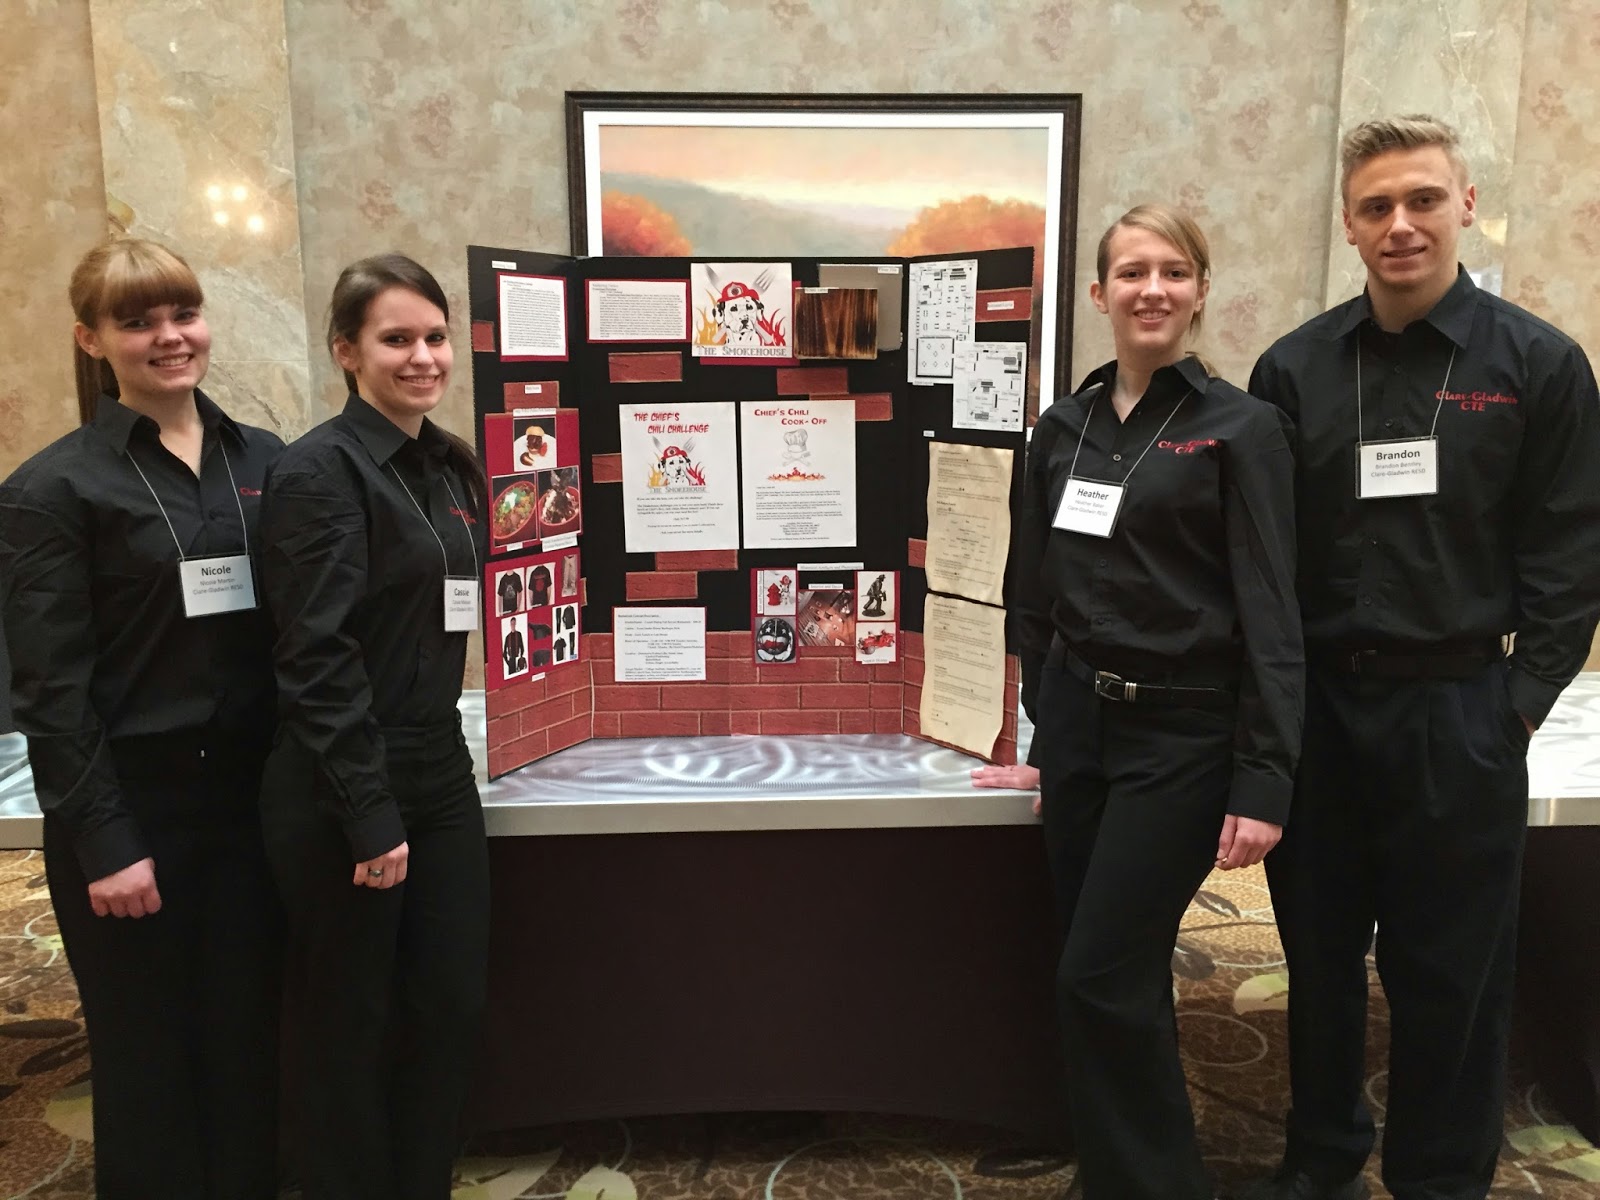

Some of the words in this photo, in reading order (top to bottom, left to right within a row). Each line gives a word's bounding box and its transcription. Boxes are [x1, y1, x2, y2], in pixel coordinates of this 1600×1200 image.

[697, 345, 717, 355] THE
[722, 345, 787, 357] SMOKEHOUSE
[1460, 401, 1485, 411] CTE
[634, 412, 648, 422] THE
[651, 412, 680, 422] CHIEF'S
[754, 407, 785, 417] CHIEF'S
[788, 408, 809, 416] CHILI
[811, 417, 828, 425] OFF
[647, 425, 665, 434] CHILI
[668, 424, 710, 434] CHALLENGE
[1376, 449, 1420, 461] Brandon
[665, 485, 707, 493] SMOKEHOUSE
[1077, 488, 1109, 500] Heather
[201, 565, 232, 576] Nicole
[453, 587, 470, 597] Cassie
